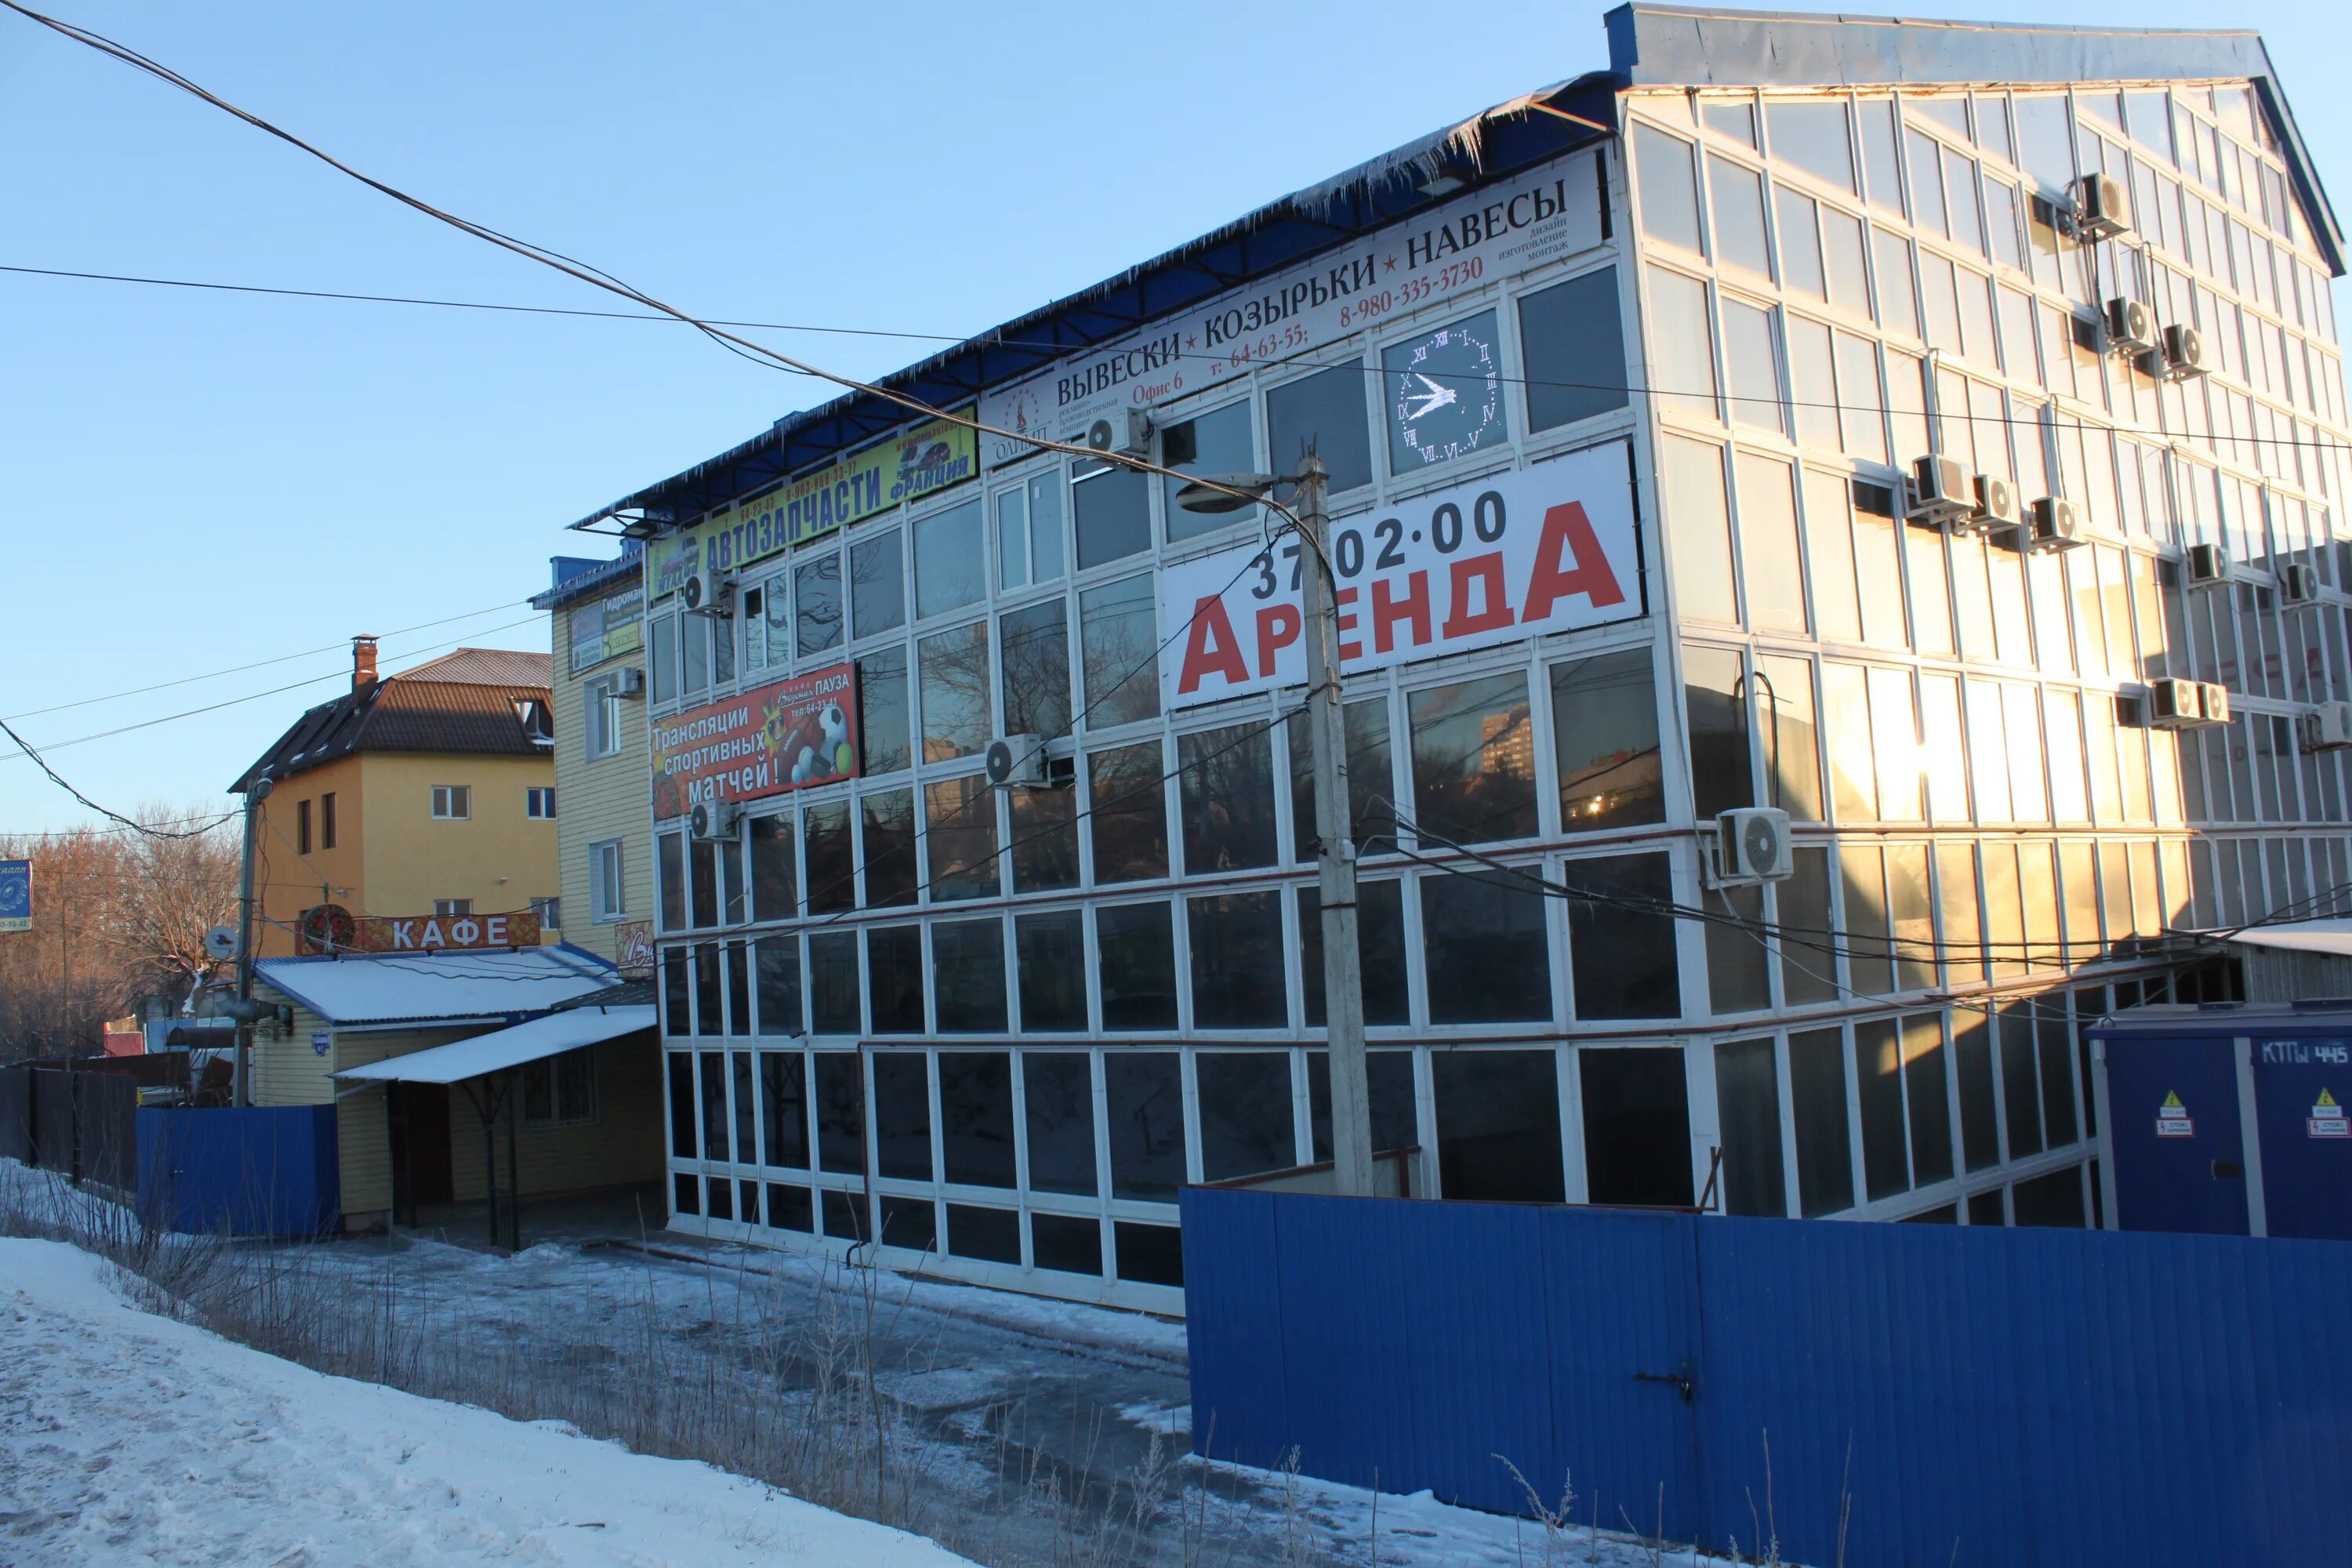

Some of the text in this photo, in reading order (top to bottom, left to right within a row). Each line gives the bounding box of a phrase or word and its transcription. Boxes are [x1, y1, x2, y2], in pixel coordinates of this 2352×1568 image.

[1530, 216, 1566, 238] дизайн
[1499, 229, 1567, 260] изготовление
[1528, 241, 1568, 262] монтаж
[1058, 179, 1566, 407] ВЫВЕСКИ КОЗЫРЬКИ НАВЕСЫ
[1133, 379, 1171, 404] Офис
[1174, 371, 1182, 389] 6
[1341, 256, 1483, 328] 8-980-335-3730
[1462, 329, 1468, 347] I
[1413, 346, 1427, 363] XI
[1479, 343, 1490, 361] II
[1400, 372, 1411, 390] X
[1398, 402, 1410, 420] IX
[1483, 402, 1496, 422] IV
[1468, 430, 1479, 448] V
[1421, 445, 1436, 463] VII
[1444, 442, 1458, 461] VI
[891, 455, 969, 499] ФРАНЦИЯ
[707, 466, 880, 570] АВТОЗАПЧАСТИ
[1178, 500, 1625, 695] АРЕНДА
[815, 673, 849, 696] ПАУЗА
[652, 706, 749, 753] Трансляции
[664, 731, 765, 776] спортивных
[394, 917, 509, 949] КАФЕ
[2315, 1045, 2348, 1063] 445
